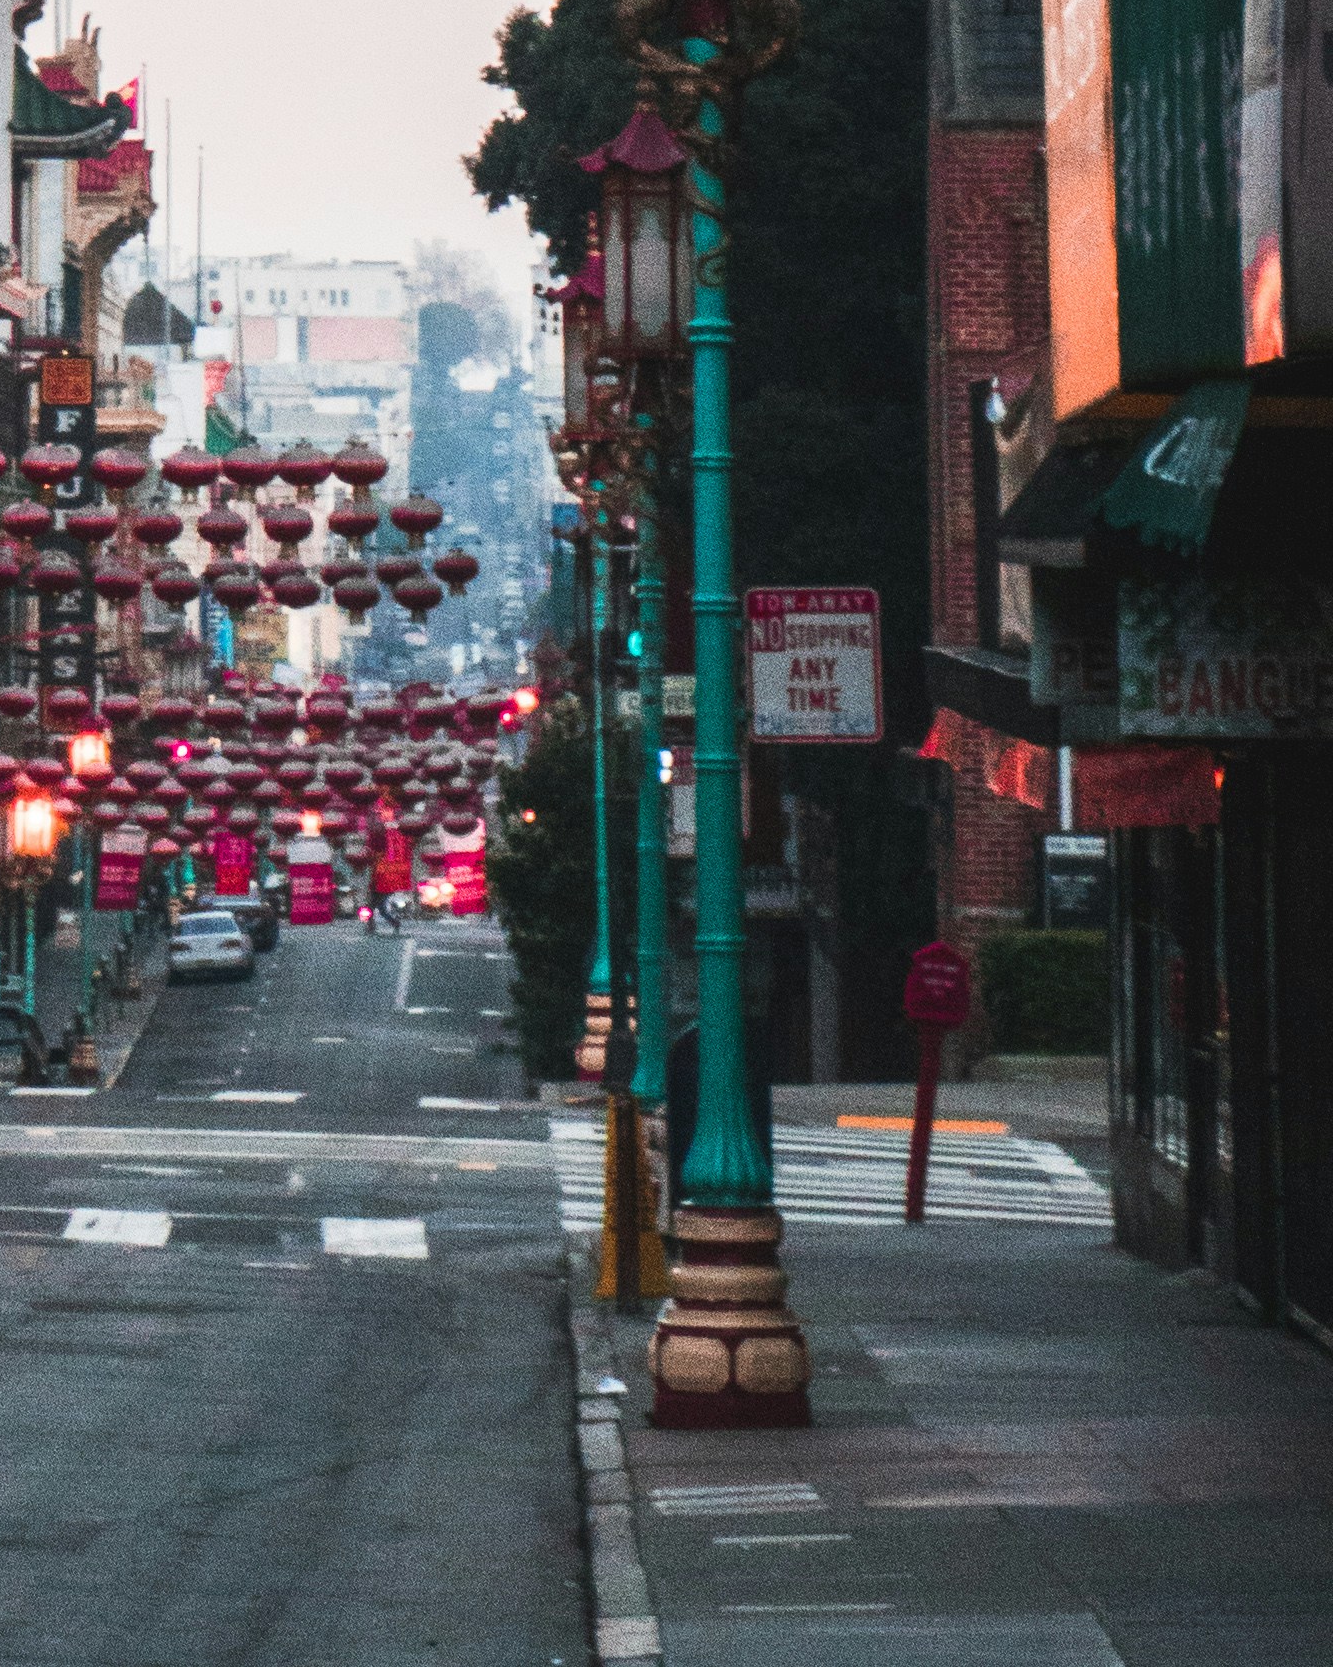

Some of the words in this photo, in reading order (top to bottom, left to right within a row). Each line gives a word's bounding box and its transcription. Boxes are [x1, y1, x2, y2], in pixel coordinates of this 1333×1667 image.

[755, 593, 868, 611] TOW-AWAY
[751, 617, 783, 649] NO
[785, 624, 872, 650] STOPPING
[789, 657, 838, 681] ANY
[787, 687, 842, 712] TIME
